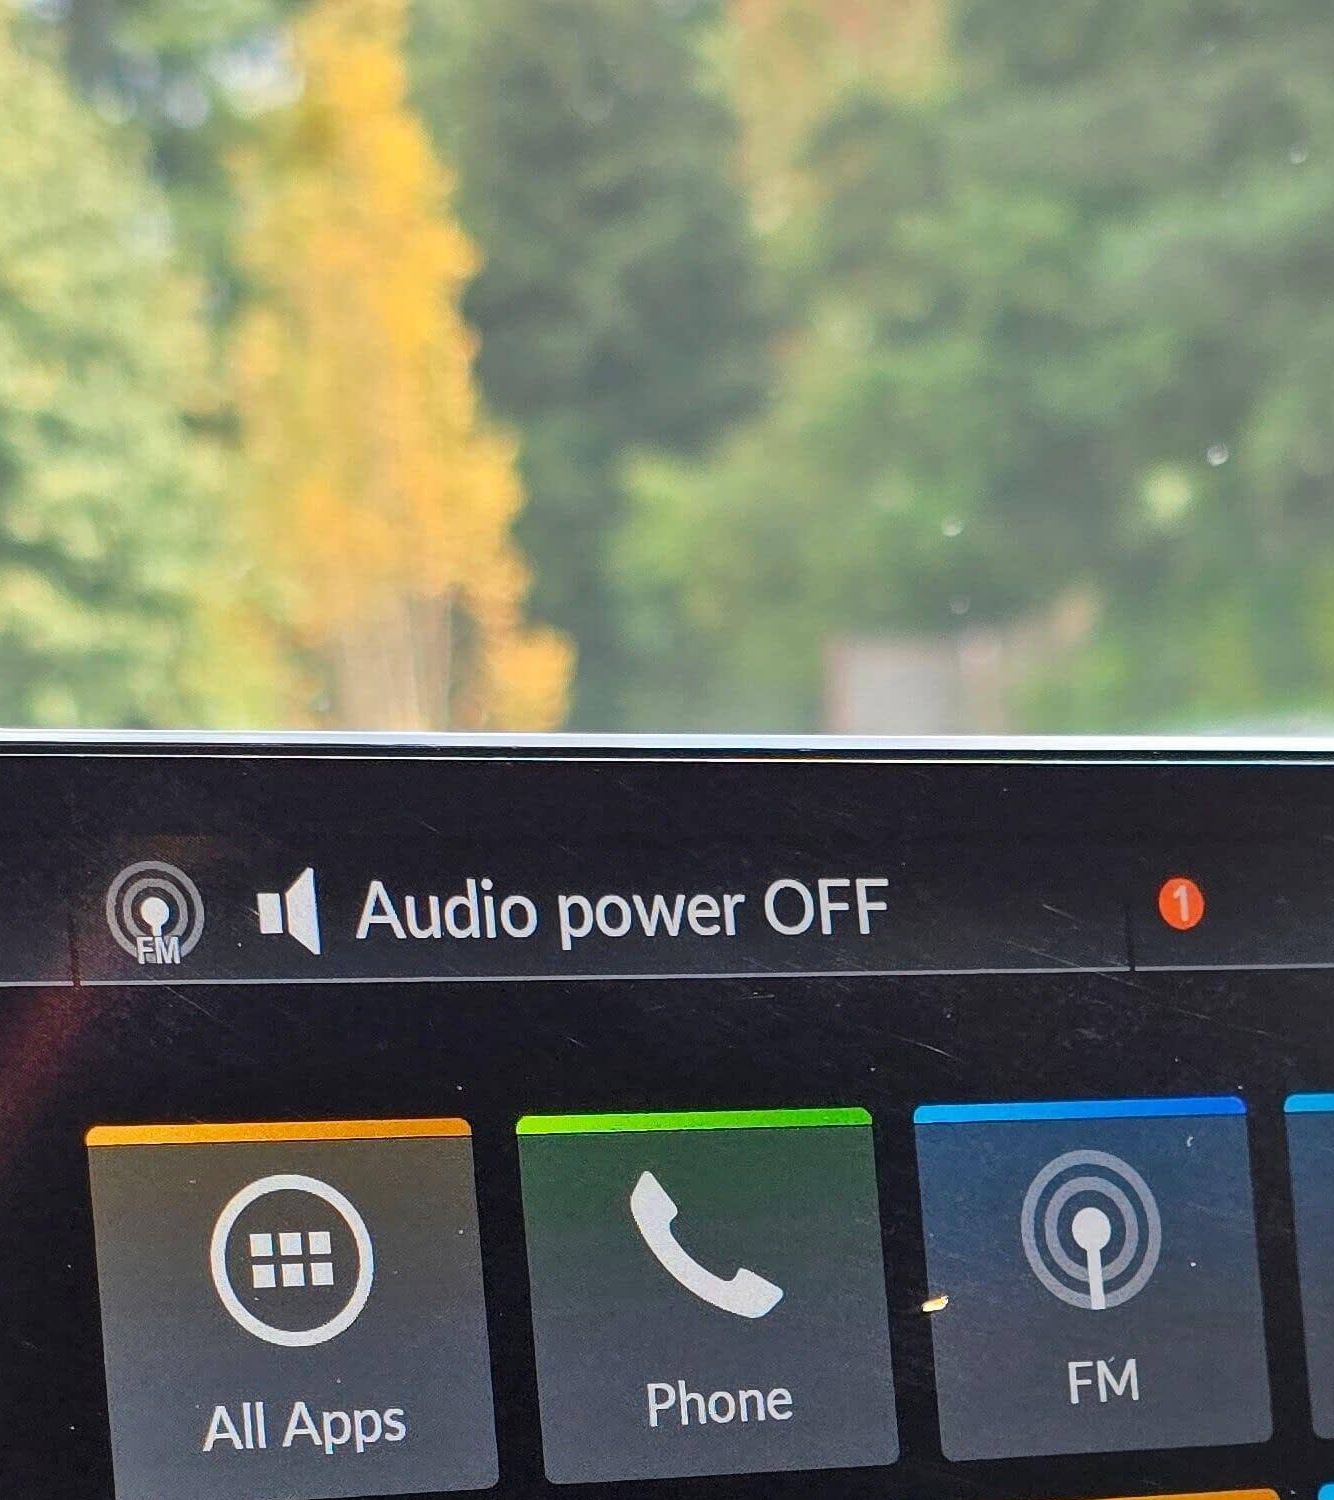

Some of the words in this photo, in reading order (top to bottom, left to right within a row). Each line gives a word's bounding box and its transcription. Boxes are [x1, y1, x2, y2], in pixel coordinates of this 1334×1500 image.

[355, 878, 538, 940] Audio
[558, 893, 746, 951] power
[764, 878, 889, 936] OFF
[646, 1379, 793, 1428] Phone
[1067, 1358, 1140, 1405] FM
[202, 1401, 267, 1452] All
[282, 1401, 407, 1455] Apps
